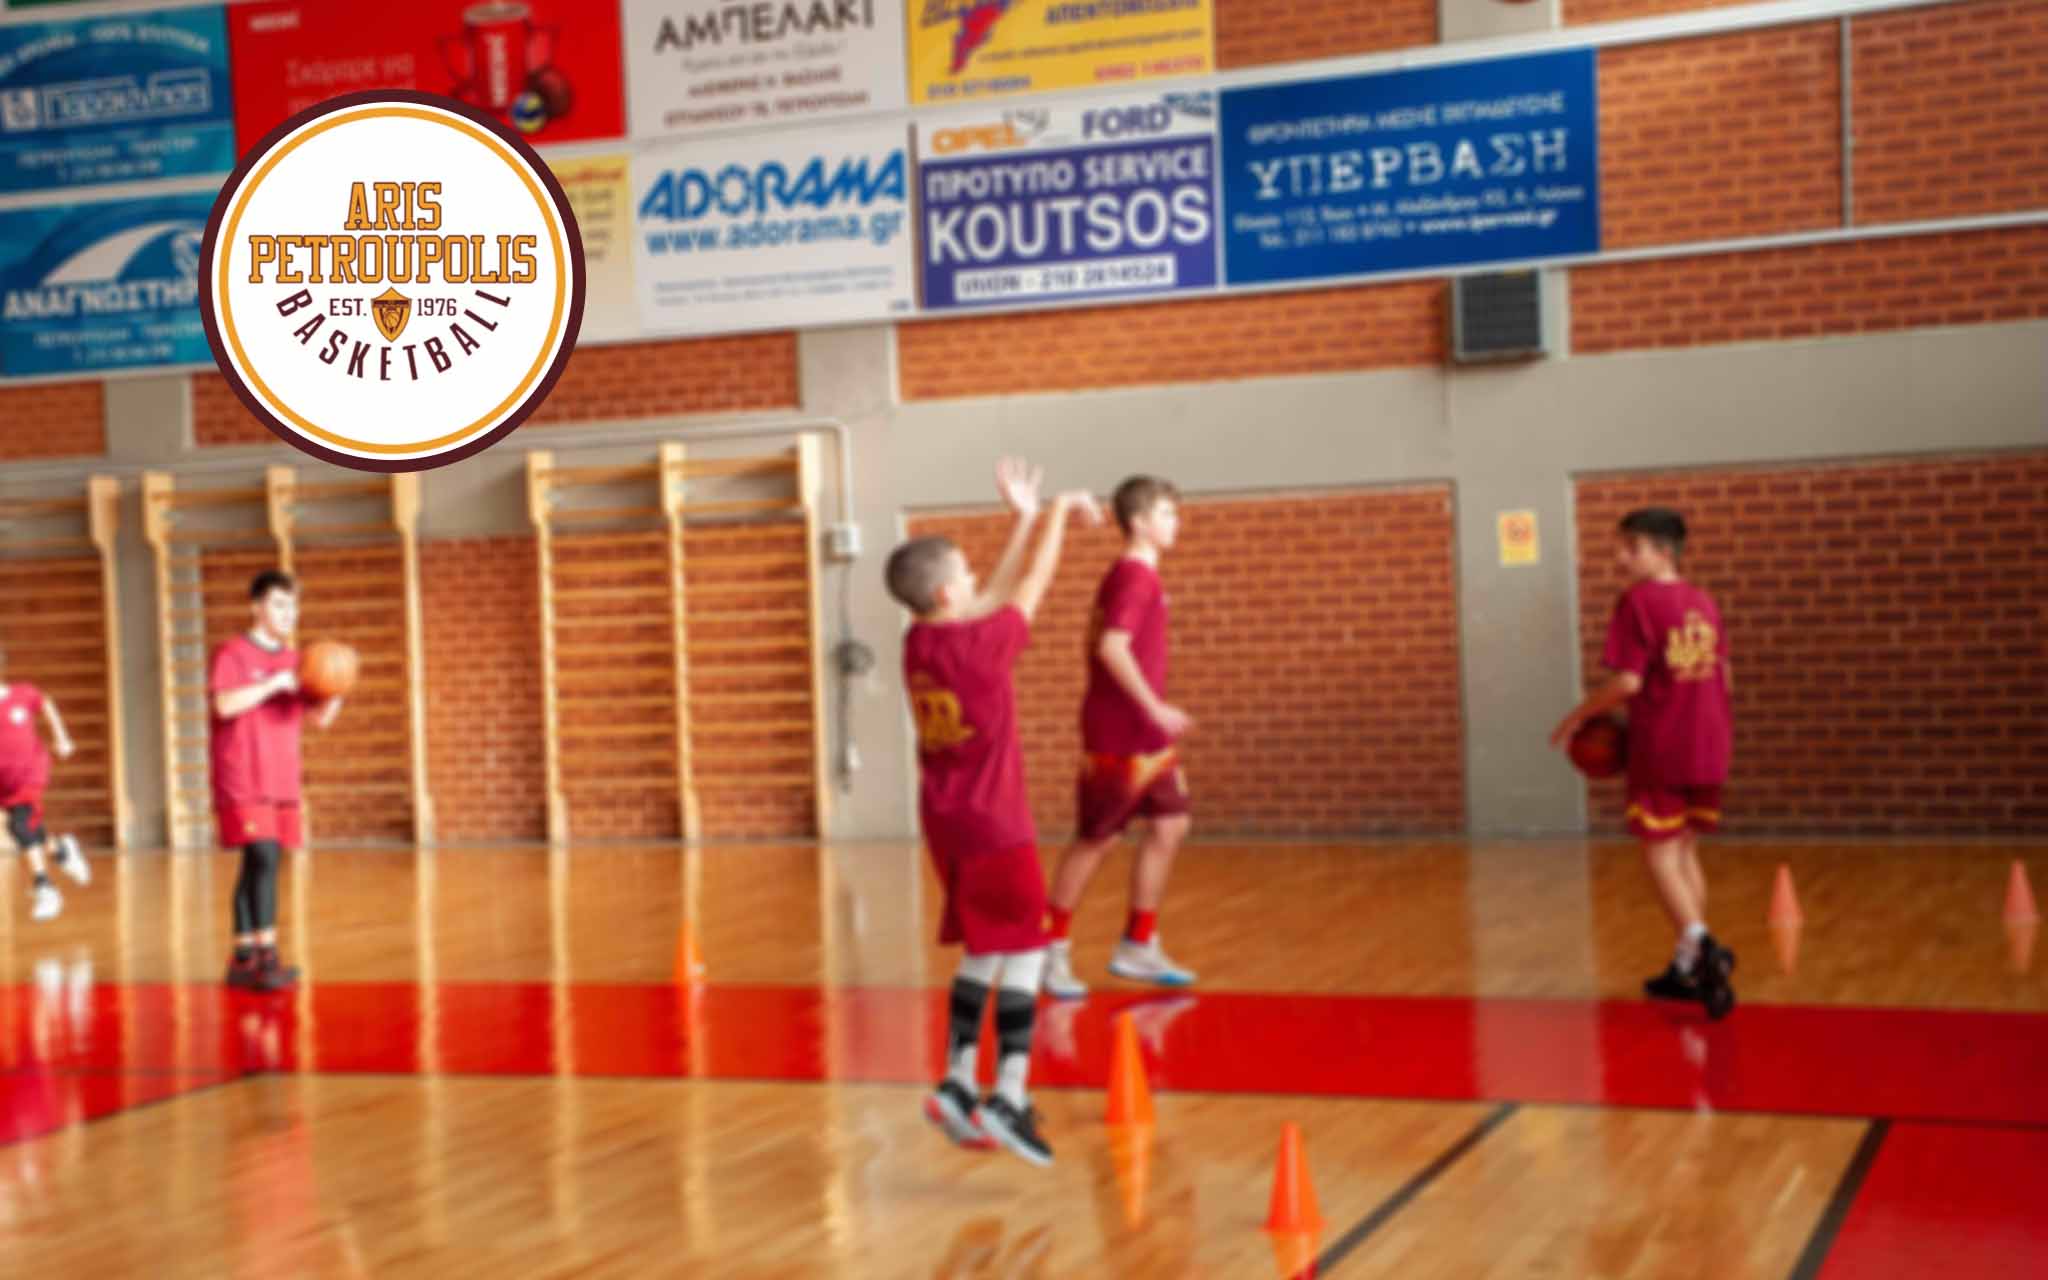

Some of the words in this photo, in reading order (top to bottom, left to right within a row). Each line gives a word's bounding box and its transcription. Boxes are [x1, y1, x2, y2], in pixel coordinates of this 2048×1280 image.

[653, 0, 875, 54] ΑΜΠΕΛΑΚΙ
[931, 122, 1024, 155] OPEL
[1082, 104, 1172, 138] FORD
[638, 149, 907, 221] ADORAMA
[926, 160, 1076, 199] ΠΡΟΤΥΠΟ
[1082, 146, 1211, 190] SERVICE
[1248, 126, 1568, 200] ΥΠΕΡΒΑΣΗ
[645, 210, 904, 255] www.adorama.gr
[927, 184, 1215, 263] KOUTSOS
